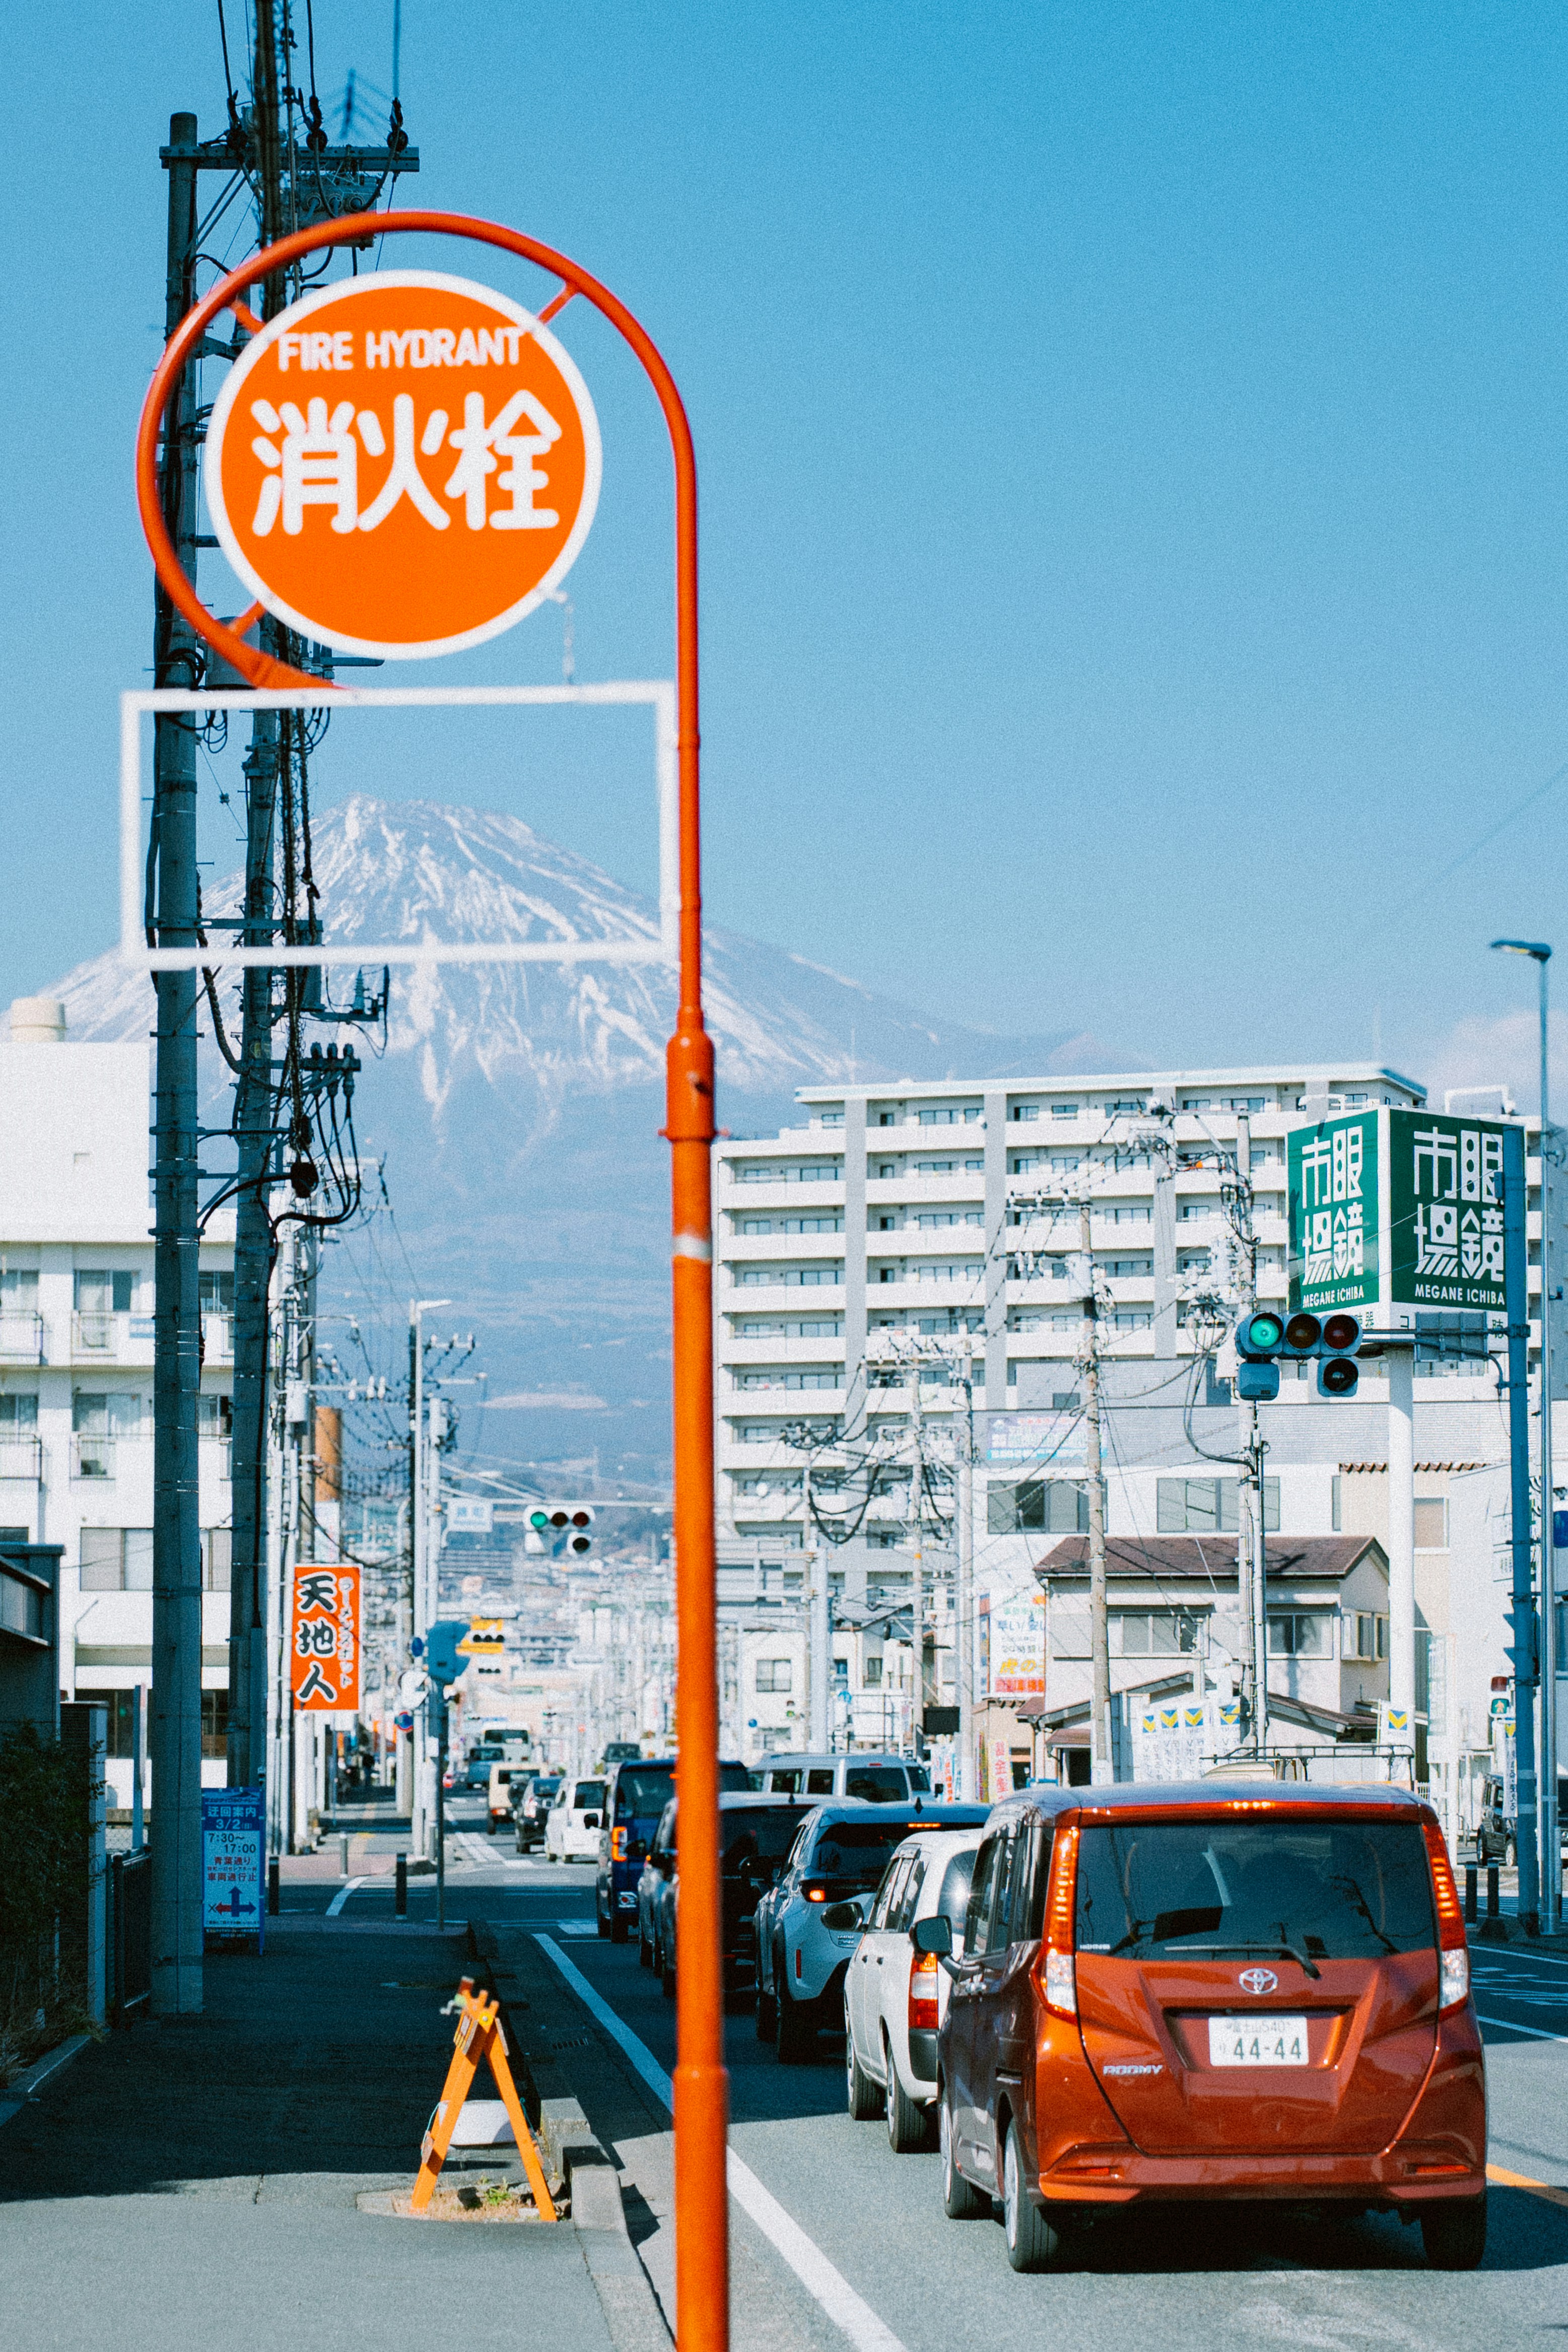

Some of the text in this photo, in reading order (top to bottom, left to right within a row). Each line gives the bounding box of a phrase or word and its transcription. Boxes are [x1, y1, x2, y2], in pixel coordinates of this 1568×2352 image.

[278, 326, 524, 371] FIRE HYDRANT
[250, 389, 562, 536] 消火栓
[1303, 1286, 1364, 1308] MEGANE ICHIBA
[1415, 1284, 1505, 1305] MEGANE ICHIBA
[296, 1572, 336, 1702] 天地人
[208, 1806, 256, 1818] 迂回案内
[225, 1844, 256, 1853] 17:00
[214, 1856, 251, 1865] 青葉通り
[208, 1872, 257, 1881] 車両通行止
[1234, 2037, 1302, 2060] 44-44
[1103, 2064, 1163, 2075] ROOMY
